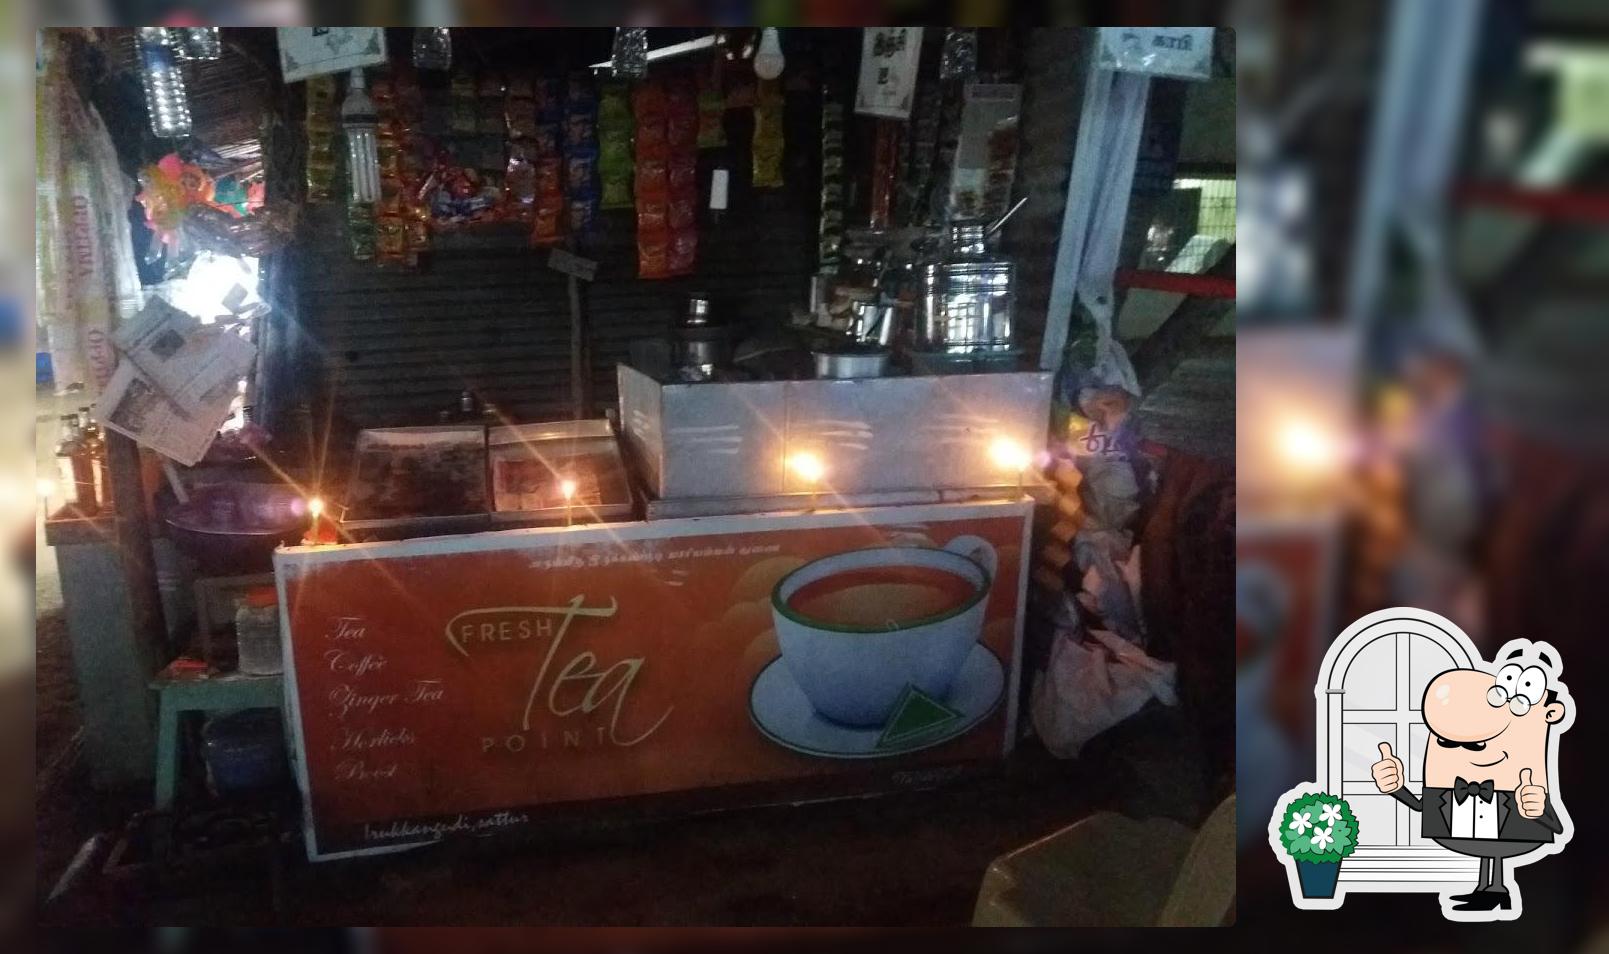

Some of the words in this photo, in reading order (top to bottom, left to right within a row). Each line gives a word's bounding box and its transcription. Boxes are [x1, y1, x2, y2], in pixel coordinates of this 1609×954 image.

[325, 616, 367, 640] Tea
[462, 618, 552, 643] FRESH
[446, 594, 674, 746] Tea
[404, 678, 445, 703] Tea
[482, 727, 606, 753] POINT
